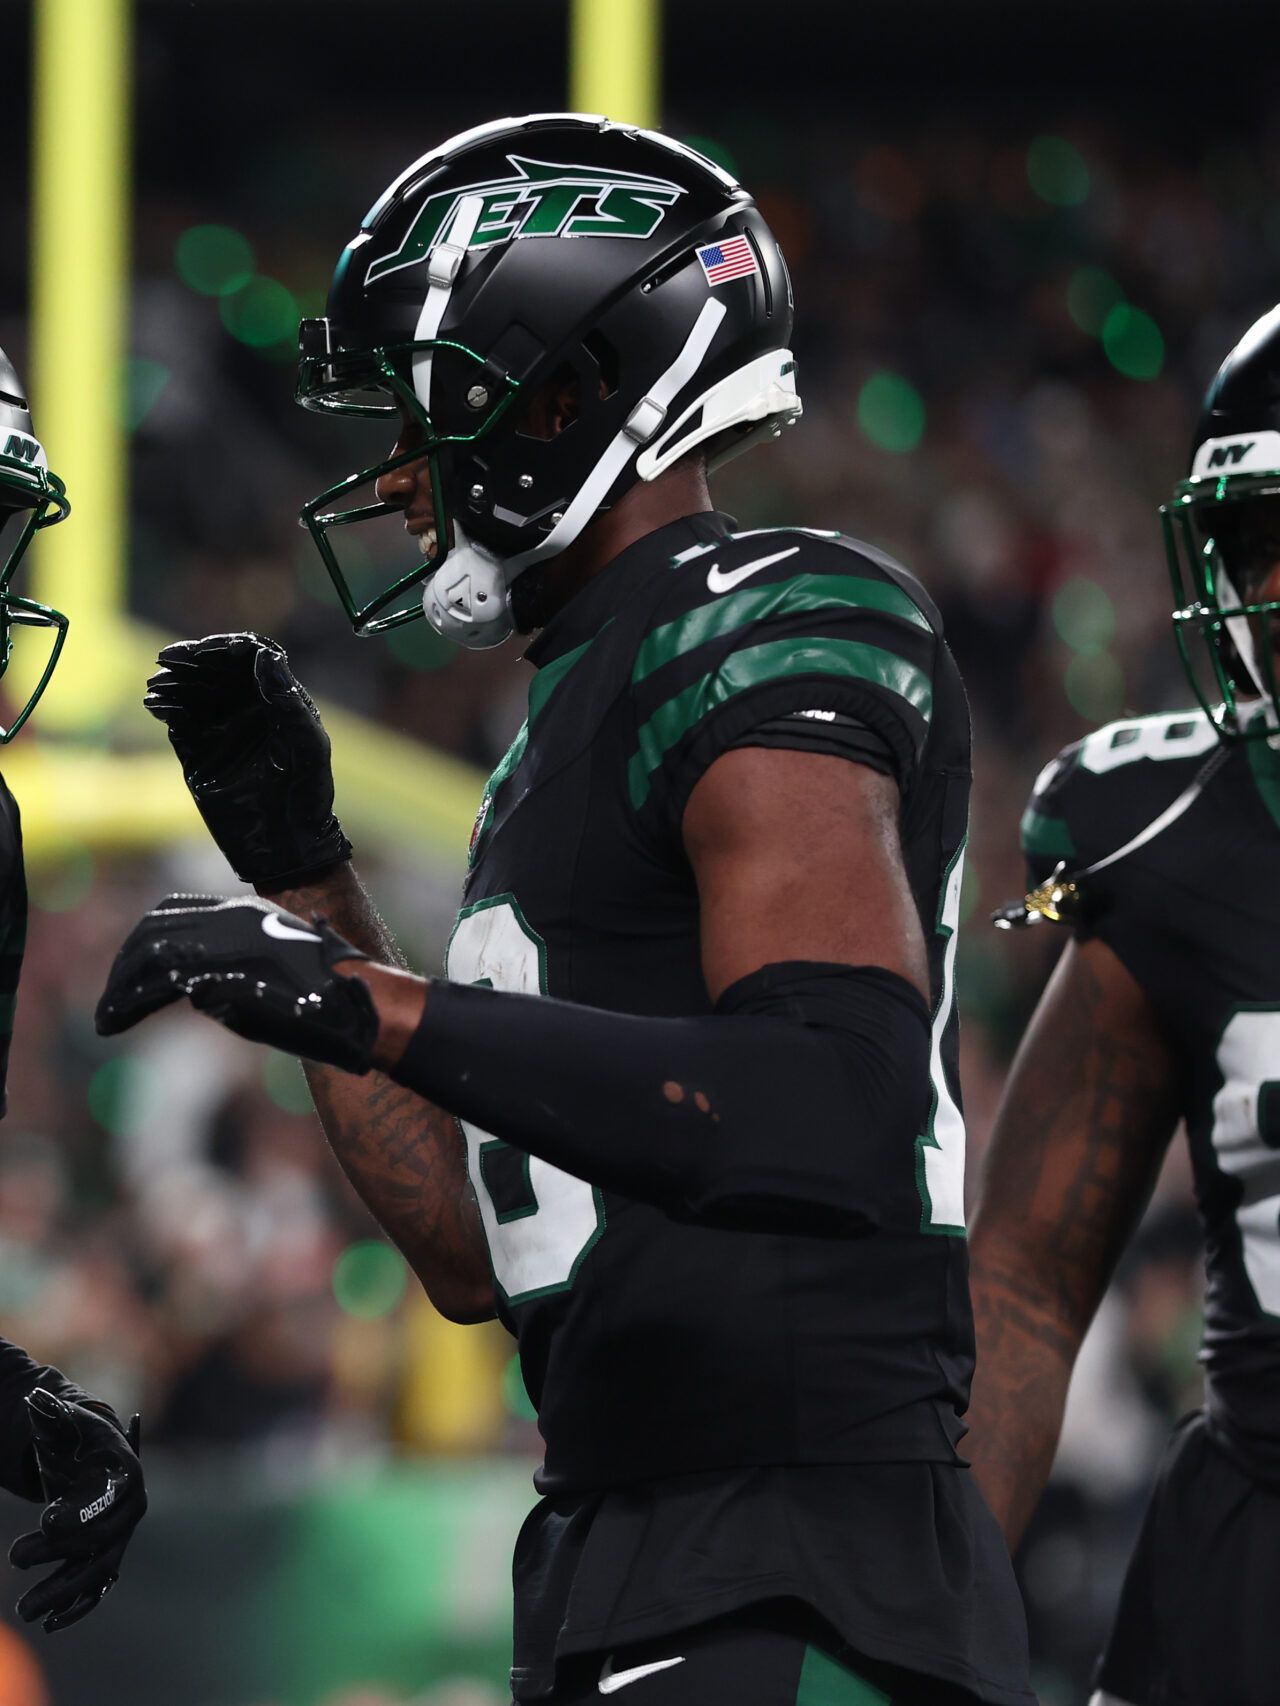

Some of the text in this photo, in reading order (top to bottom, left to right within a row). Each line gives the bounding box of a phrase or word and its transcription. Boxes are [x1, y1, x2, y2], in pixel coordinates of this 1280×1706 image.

[363, 154, 689, 287] JETS
[4, 434, 40, 462] NY
[1207, 442, 1255, 468] NY
[80, 1485, 116, 1523] ADIZERO
